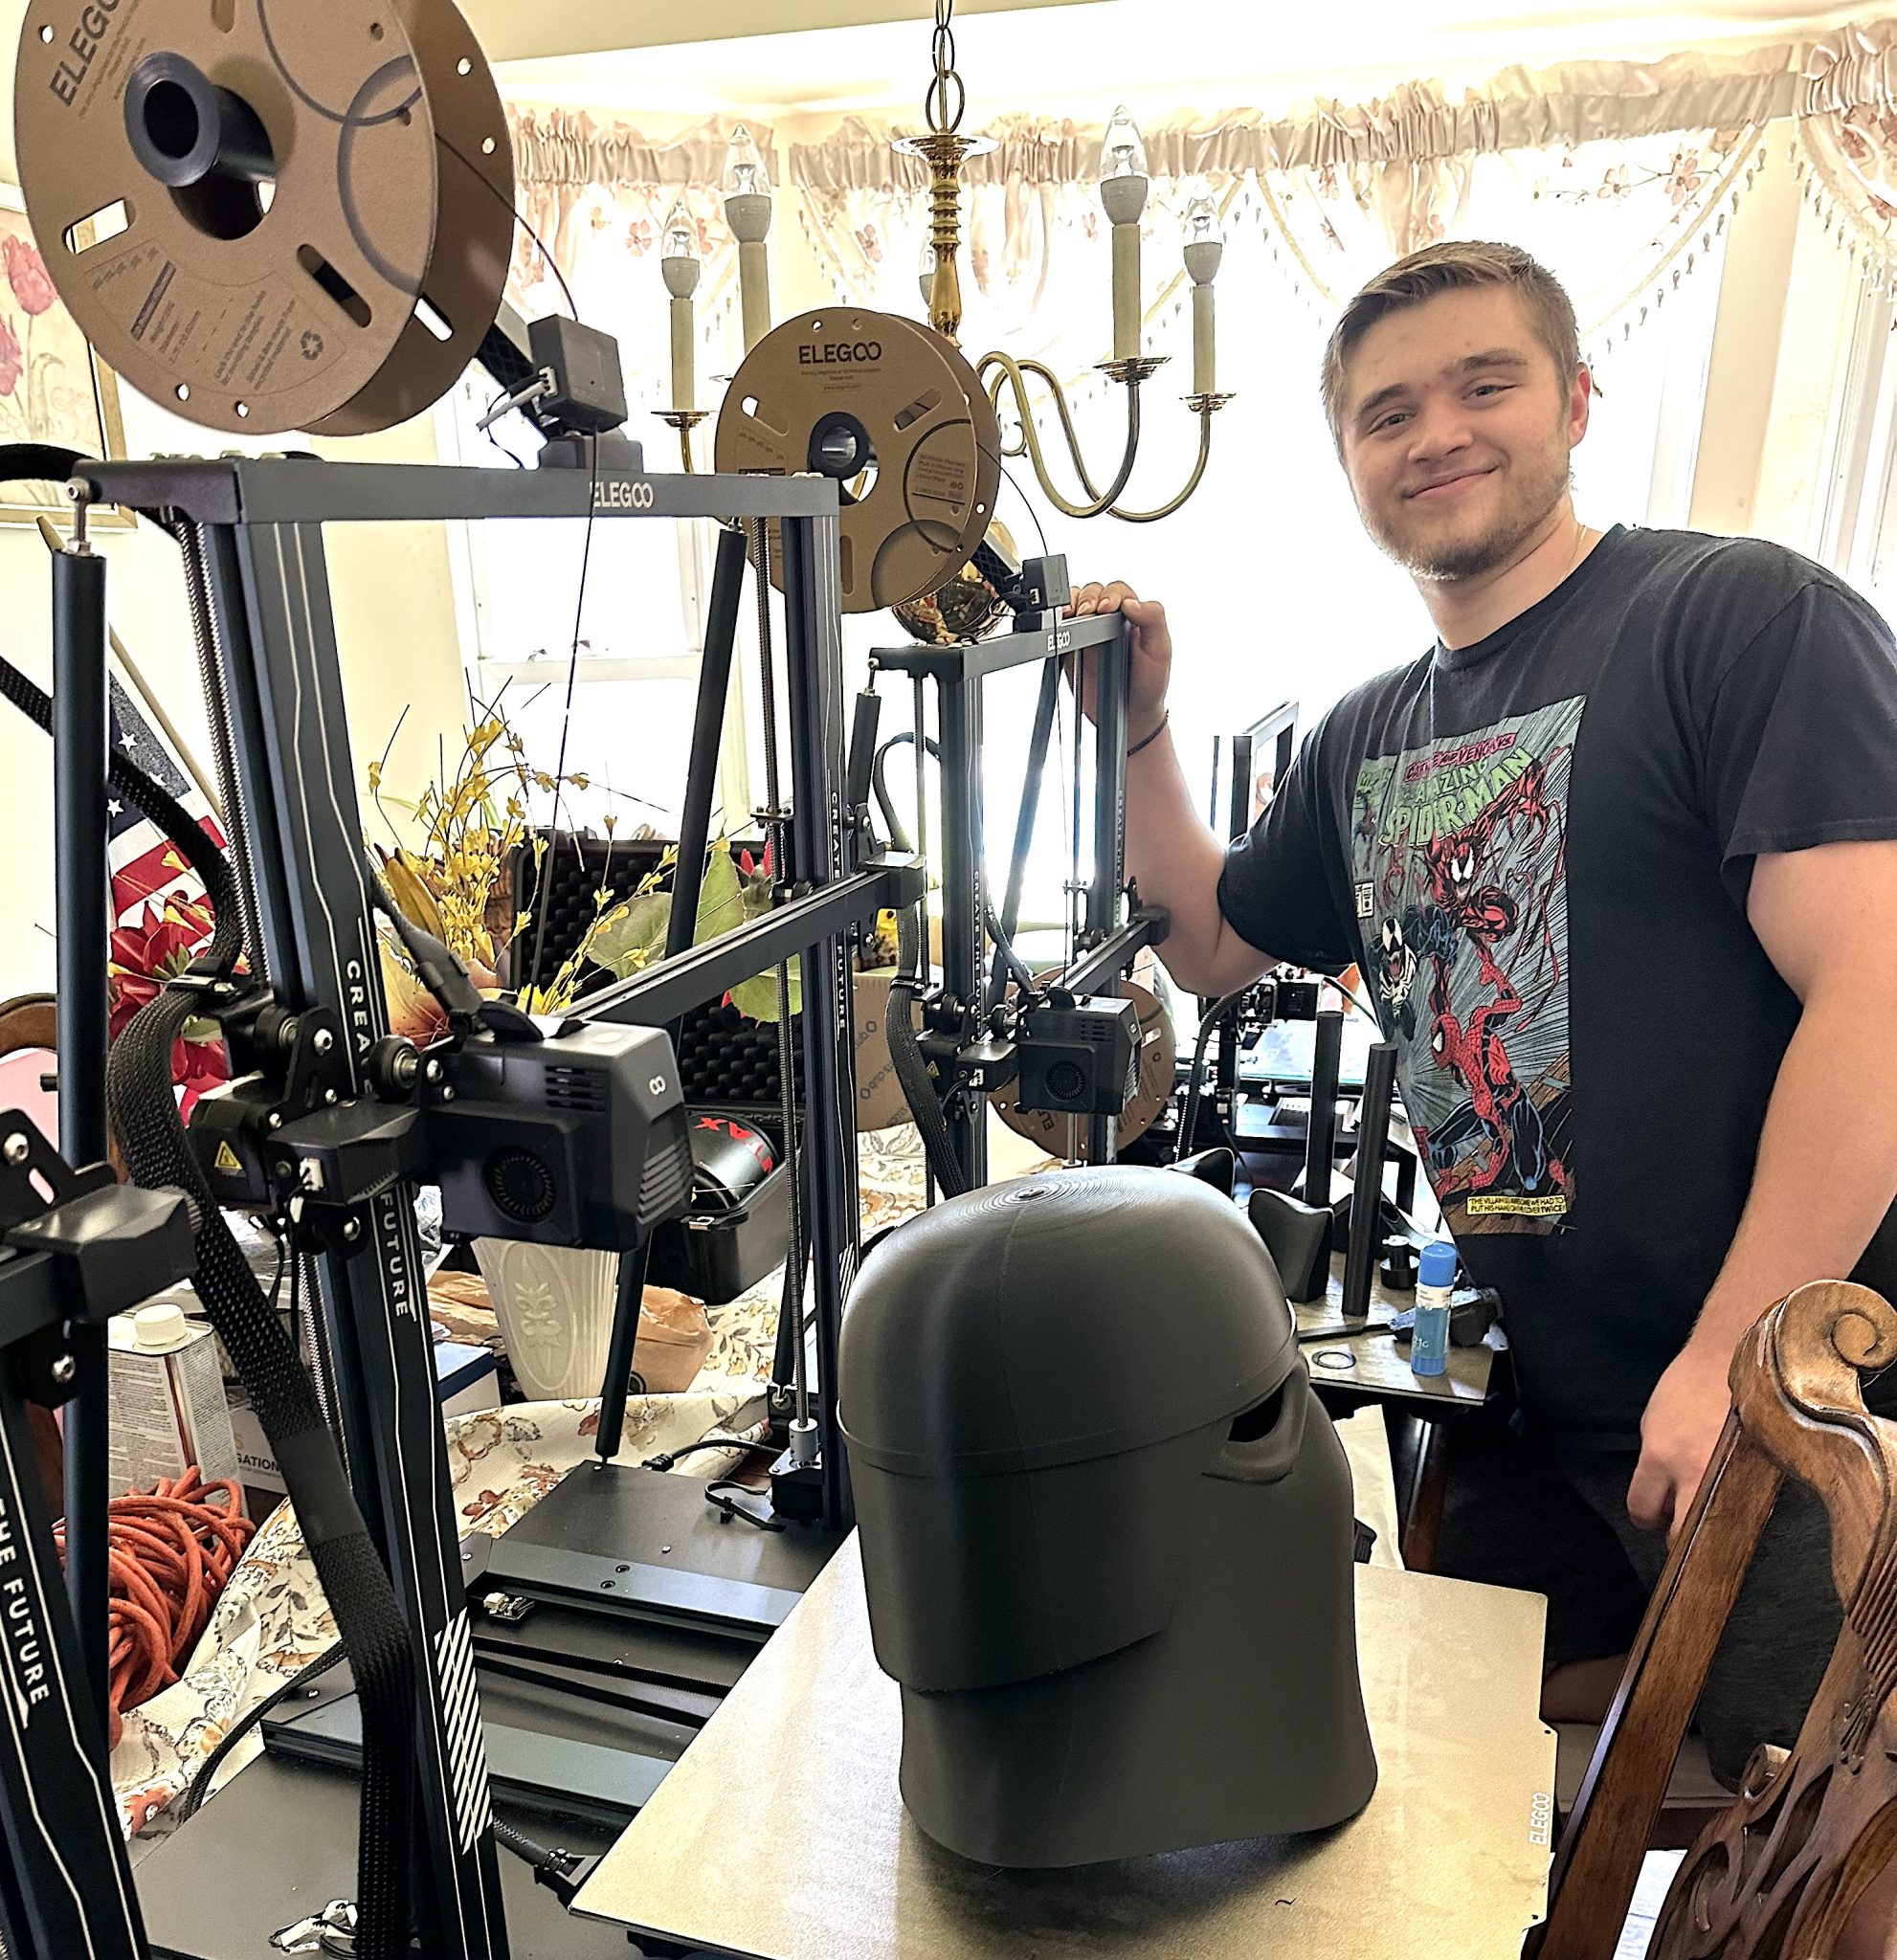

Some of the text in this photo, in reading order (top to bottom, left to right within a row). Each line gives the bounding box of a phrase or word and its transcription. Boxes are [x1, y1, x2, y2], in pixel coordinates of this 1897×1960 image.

[798, 342, 882, 364] ELEGOO
[589, 481, 654, 508] ELEGOO
[831, 791, 840, 880] CREATE
[837, 945, 846, 1029] FUTURE
[380, 1192, 409, 1318] FUTURE
[3, 1577, 50, 1705] FUTURE
[1528, 1792, 1551, 1845] ELEGOO
